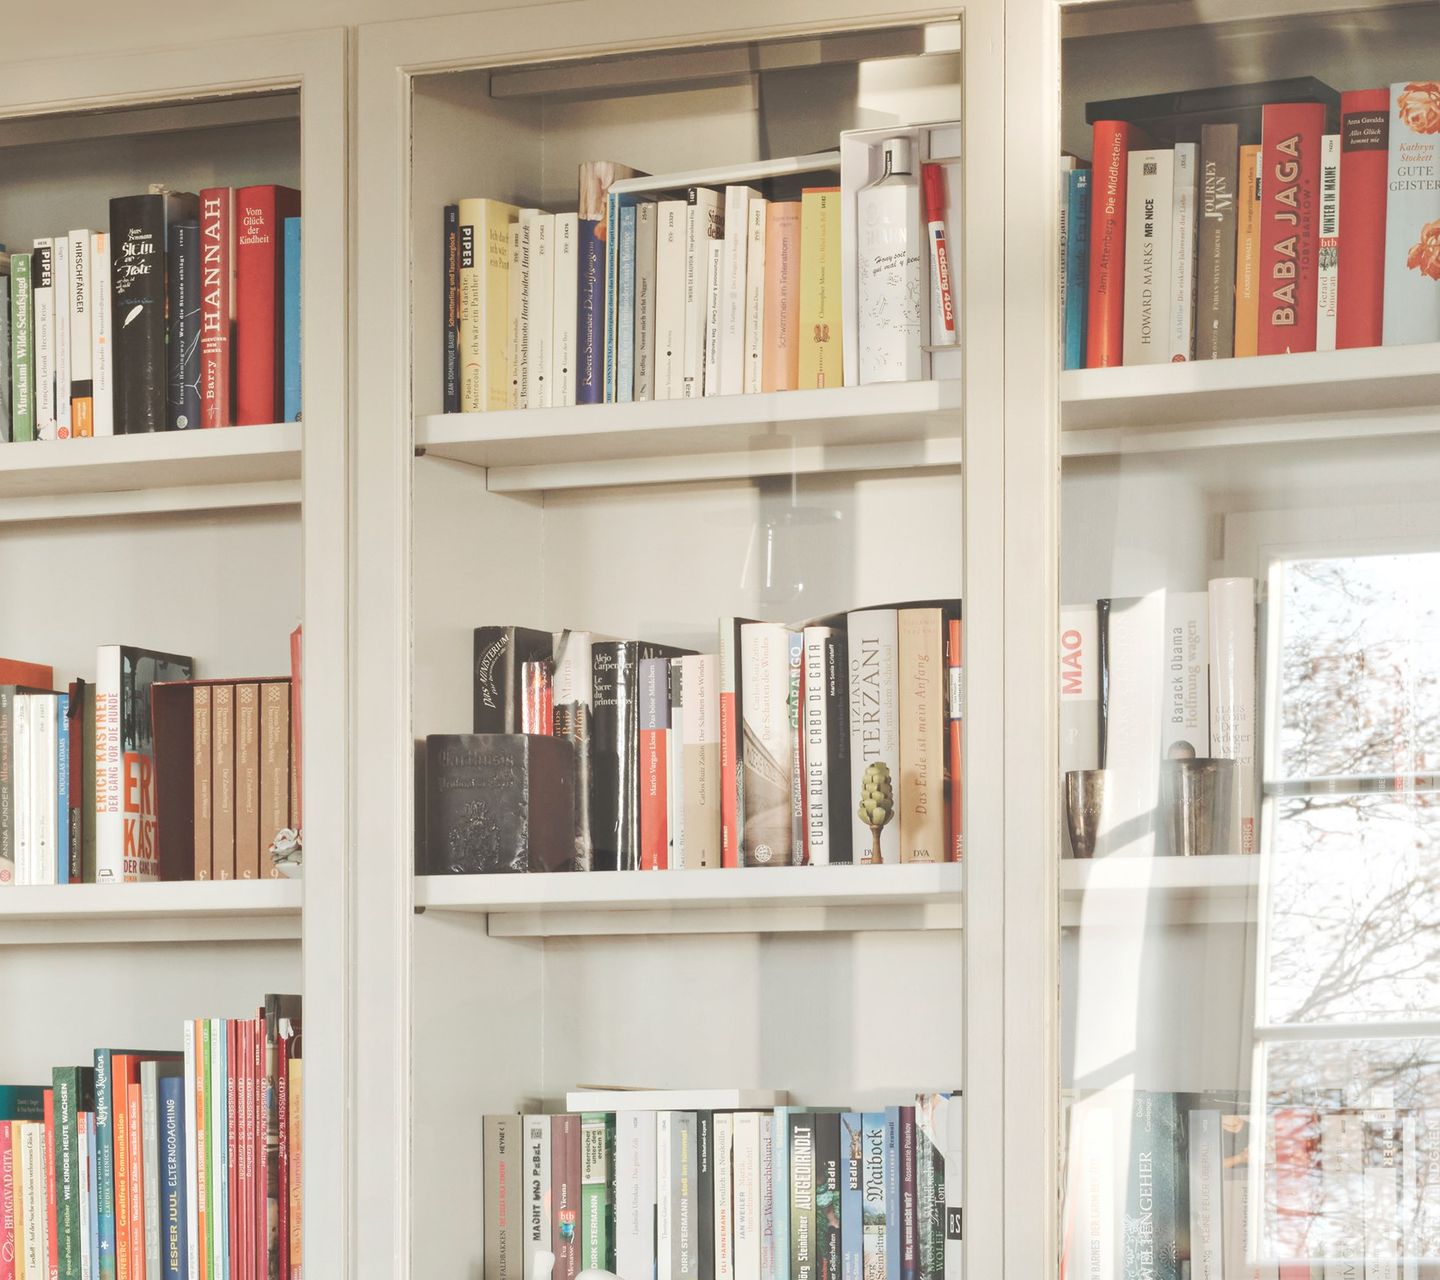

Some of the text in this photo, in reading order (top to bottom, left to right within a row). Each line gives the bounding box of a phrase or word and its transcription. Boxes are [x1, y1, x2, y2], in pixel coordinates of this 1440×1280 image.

[1324, 166, 1336, 190] MAINE
[463, 228, 471, 266] PIPER
[1272, 135, 1299, 325] BABA JAGA
[1324, 205, 1335, 234] WINTER
[75, 241, 84, 313] HIRSCHFÄNGER
[204, 198, 220, 399] Barry HANNAH
[938, 248, 953, 320] edding 404
[1141, 199, 1154, 344] HOWARD MARKS MR NICE
[17, 277, 28, 414] Murakami Wilde Schafsjagd
[852, 660, 860, 735] TIZIANO
[863, 638, 880, 761] TERZANI
[1062, 630, 1082, 695] MAO
[1171, 627, 1183, 723] Barack Obama
[1185, 620, 1200, 728] Hoffnung wagen
[809, 644, 823, 845] EUGEN RUGE CABO DE GATA
[166, 1100, 176, 1187] ELTERNCOACHING
[794, 1126, 811, 1210] AUFGEDIRNDLT
[828, 1161, 836, 1190] PIPER
[866, 1130, 883, 1201] Maibock
[4, 1149, 13, 1229] BHAGAVAD GITA
[168, 1192, 177, 1221] JUUL
[169, 1225, 178, 1271] JESPER
